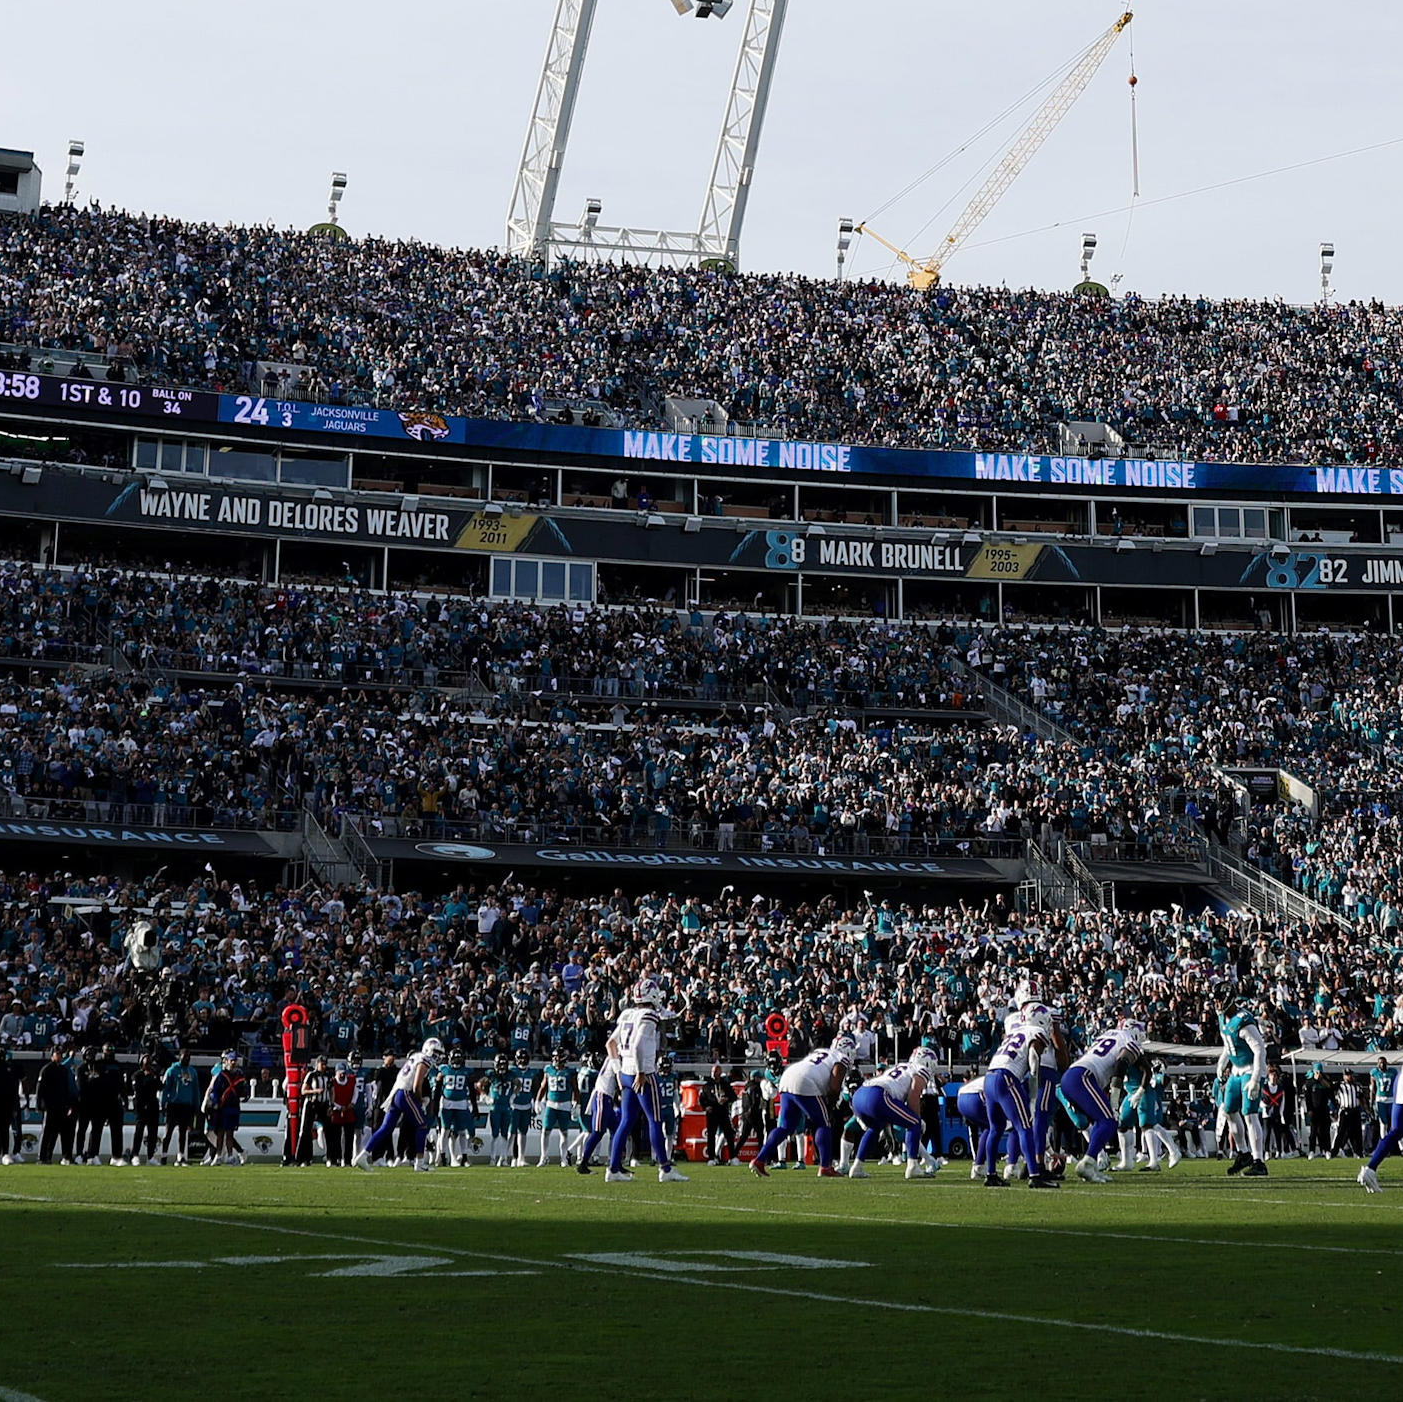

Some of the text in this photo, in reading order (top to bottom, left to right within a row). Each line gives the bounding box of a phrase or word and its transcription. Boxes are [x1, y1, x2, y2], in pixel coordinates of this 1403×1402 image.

[60, 382, 141, 409] 1ST & 10
[152, 388, 192, 402] BALL ON
[163, 401, 182, 415] 34
[233, 396, 269, 426] 24
[276, 402, 301, 415] T.O.L.
[310, 406, 380, 422] JACKSONVILLE
[282, 412, 292, 427] 3
[322, 419, 366, 433] JAGUARS
[623, 429, 851, 473] MAKE SOME NOISE
[974, 452, 1197, 489] MAKE SOME NOISE
[1316, 466, 1381, 494] MAKE
[139, 488, 450, 542] WAYNE AND DELORES WEAVER
[471, 518, 507, 531] 1993-
[479, 531, 508, 544] 2011
[790, 537, 964, 571] 8 MARK BRUNELL
[984, 549, 1018, 561] 1995-
[990, 560, 1020, 573] 2003
[1318, 558, 1348, 584] 82
[535, 848, 946, 873] Gallagher INSURANCE
[659, 1082, 675, 1097] 12
